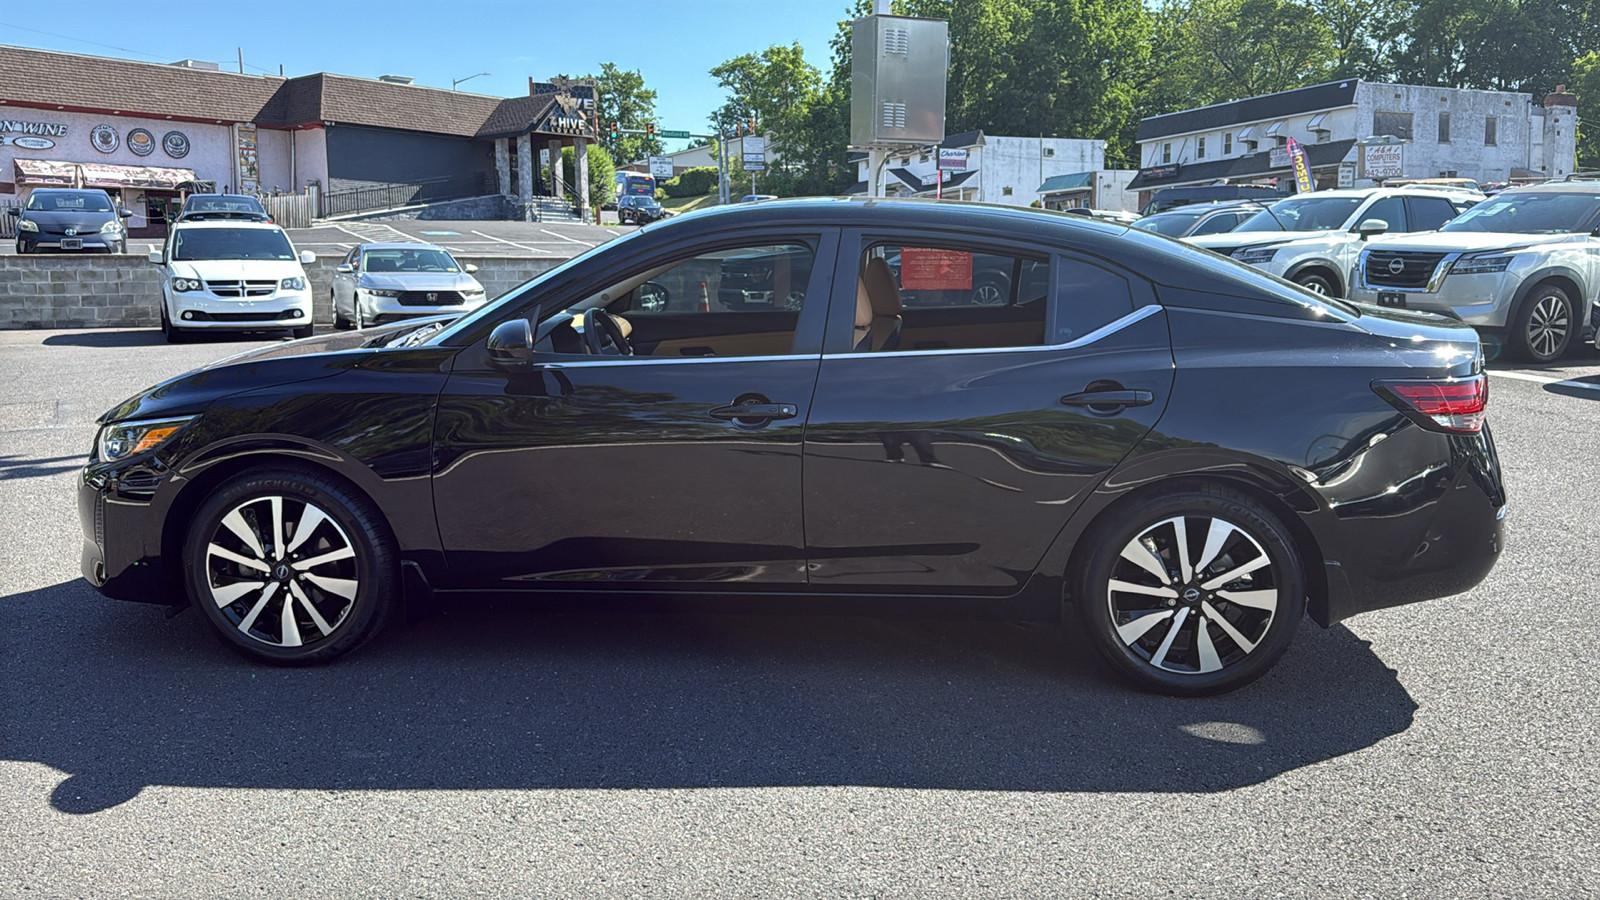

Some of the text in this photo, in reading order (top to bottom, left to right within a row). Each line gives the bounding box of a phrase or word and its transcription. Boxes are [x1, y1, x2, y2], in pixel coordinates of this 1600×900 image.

[21, 121, 68, 137] WINE
[558, 117, 586, 130] HIVE
[1366, 153, 1401, 162] COMPUTERS
[1365, 168, 1402, 178] 942-9700
